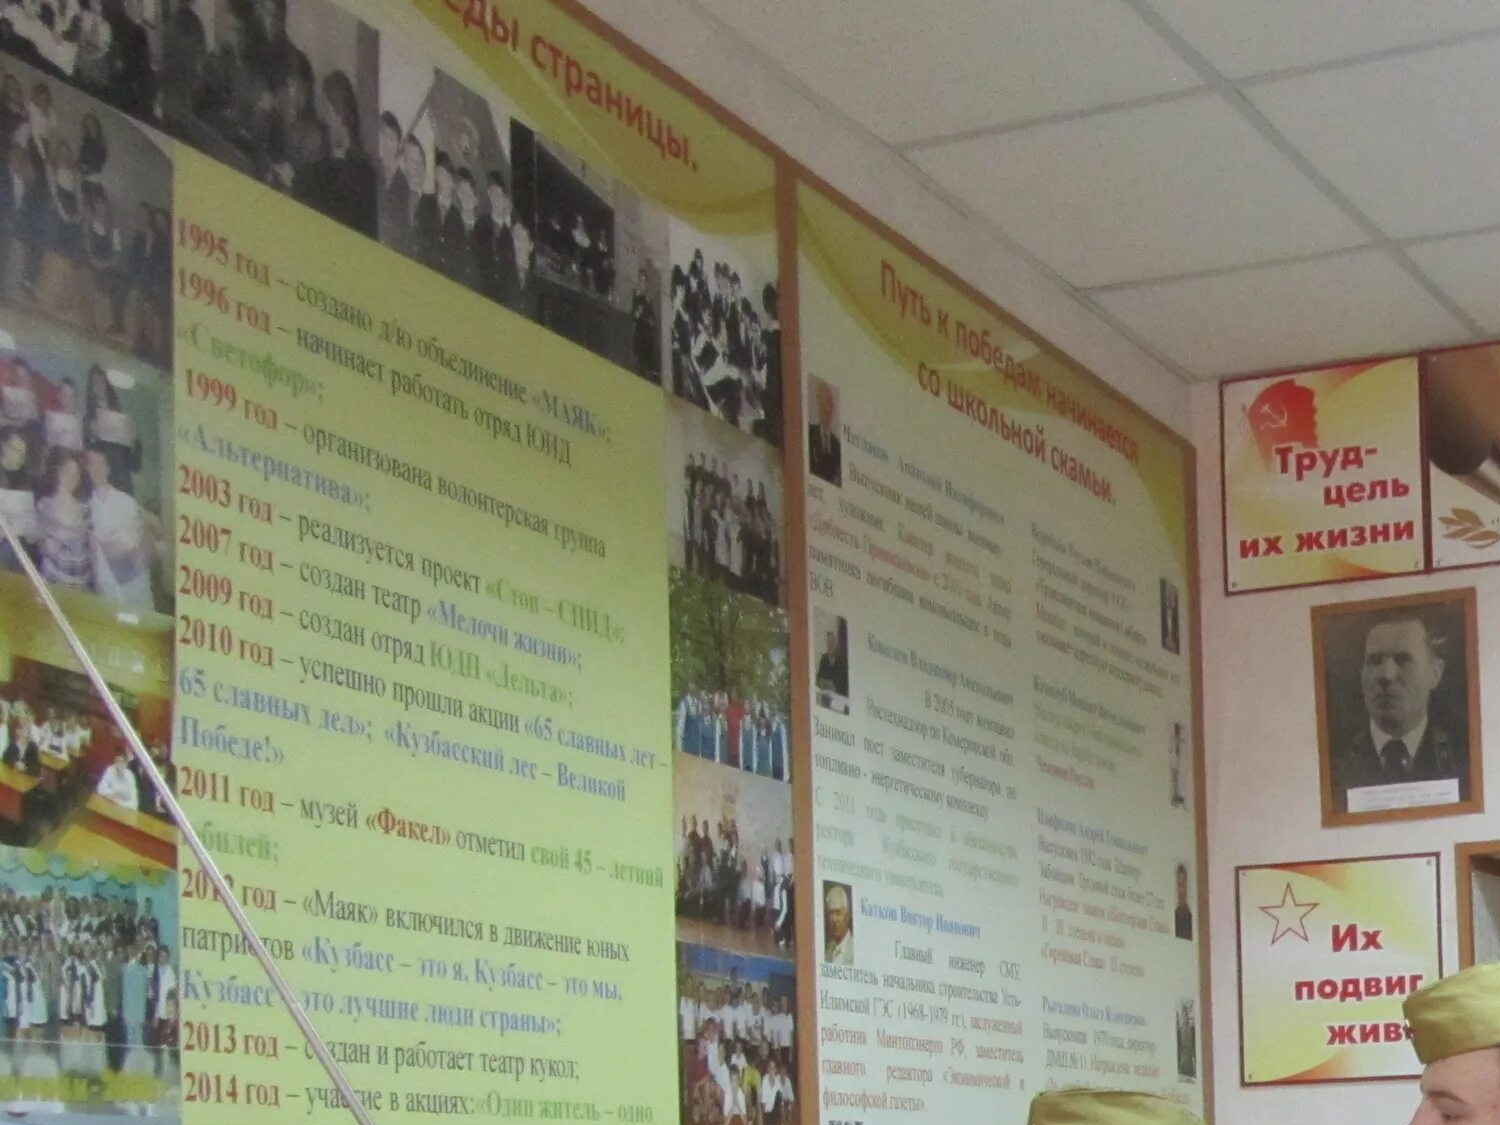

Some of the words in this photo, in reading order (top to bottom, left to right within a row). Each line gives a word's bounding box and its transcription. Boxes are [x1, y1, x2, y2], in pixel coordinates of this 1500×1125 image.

[531, 35, 697, 173] страницы.
[178, 219, 228, 266] 1995
[236, 252, 270, 287] год
[296, 281, 372, 332] создано
[417, 336, 527, 403] объединение
[178, 267, 229, 314] 1996
[236, 302, 271, 335] год
[297, 328, 385, 382] начинает
[392, 370, 469, 419] работать
[474, 407, 521, 444] отряд
[880, 259, 931, 327] Путь
[938, 308, 949, 338] к
[955, 320, 1043, 398] победам
[1046, 380, 1138, 463] начинается
[185, 368, 237, 409] 1999
[244, 398, 277, 431] год
[303, 423, 432, 492] организована
[438, 476, 548, 536] волонтерская
[917, 361, 940, 398] со
[947, 379, 1045, 462] школьной
[1051, 443, 1116, 506] скамьи.
[1274, 445, 1378, 481] Труд-
[178, 464, 231, 508] 2003
[238, 494, 272, 524] год
[299, 514, 414, 571] реализуется
[422, 557, 481, 595] проект
[1323, 478, 1410, 508] цель
[179, 515, 231, 555] 2007
[239, 542, 273, 573] год
[300, 562, 365, 600] создан
[372, 584, 421, 623] театр
[428, 600, 508, 646] «Мелочи
[1239, 536, 1284, 559] их
[1295, 520, 1414, 553] жизни
[178, 565, 232, 604] 2009
[239, 591, 273, 620] год
[300, 609, 365, 646] создан
[371, 631, 425, 667] отряд
[179, 615, 232, 656] 2010
[239, 639, 274, 669] год
[300, 656, 385, 697] успешно
[393, 680, 463, 719] прошли
[469, 703, 520, 734] акции
[558, 728, 626, 763] славных
[630, 746, 656, 770] лет
[179, 666, 206, 698] 65
[213, 681, 311, 725] славных
[385, 720, 504, 772] «Кузбасский
[509, 756, 537, 781] лес
[557, 761, 626, 802] Великой
[179, 715, 284, 764] Победе!»
[181, 765, 230, 803] 2011
[240, 785, 275, 814] год
[301, 798, 359, 829] музей
[366, 807, 451, 846] «Факел»
[457, 831, 525, 861] отметил
[530, 842, 569, 870] свой
[574, 849, 593, 873] 45
[609, 861, 664, 888] летний
[242, 884, 276, 912] год
[303, 889, 378, 925] «Маяк»
[385, 907, 483, 941] включился
[490, 924, 498, 943] в
[503, 925, 582, 956] движение
[587, 939, 630, 962] юных
[301, 935, 394, 974] «Кузбасс
[474, 957, 543, 992] Кузбасс
[1331, 923, 1383, 952] Их
[182, 968, 275, 1009] Кузбасс
[340, 996, 419, 1023] лучшие
[425, 1003, 474, 1027] люди
[480, 1006, 561, 1036] страны»;
[1295, 974, 1423, 1002] подвиг
[183, 1020, 237, 1055] 2013
[244, 1033, 278, 1058] год
[304, 1040, 370, 1065] сздан
[377, 1047, 388, 1065] и
[394, 1040, 475, 1074] работает
[480, 1053, 524, 1081] театр
[530, 1058, 580, 1083] кукол;
[1327, 1022, 1413, 1045] жив
[184, 1071, 238, 1104] 2014
[246, 1082, 280, 1108] год
[389, 1092, 400, 1111] в
[618, 1103, 654, 1123] одно
